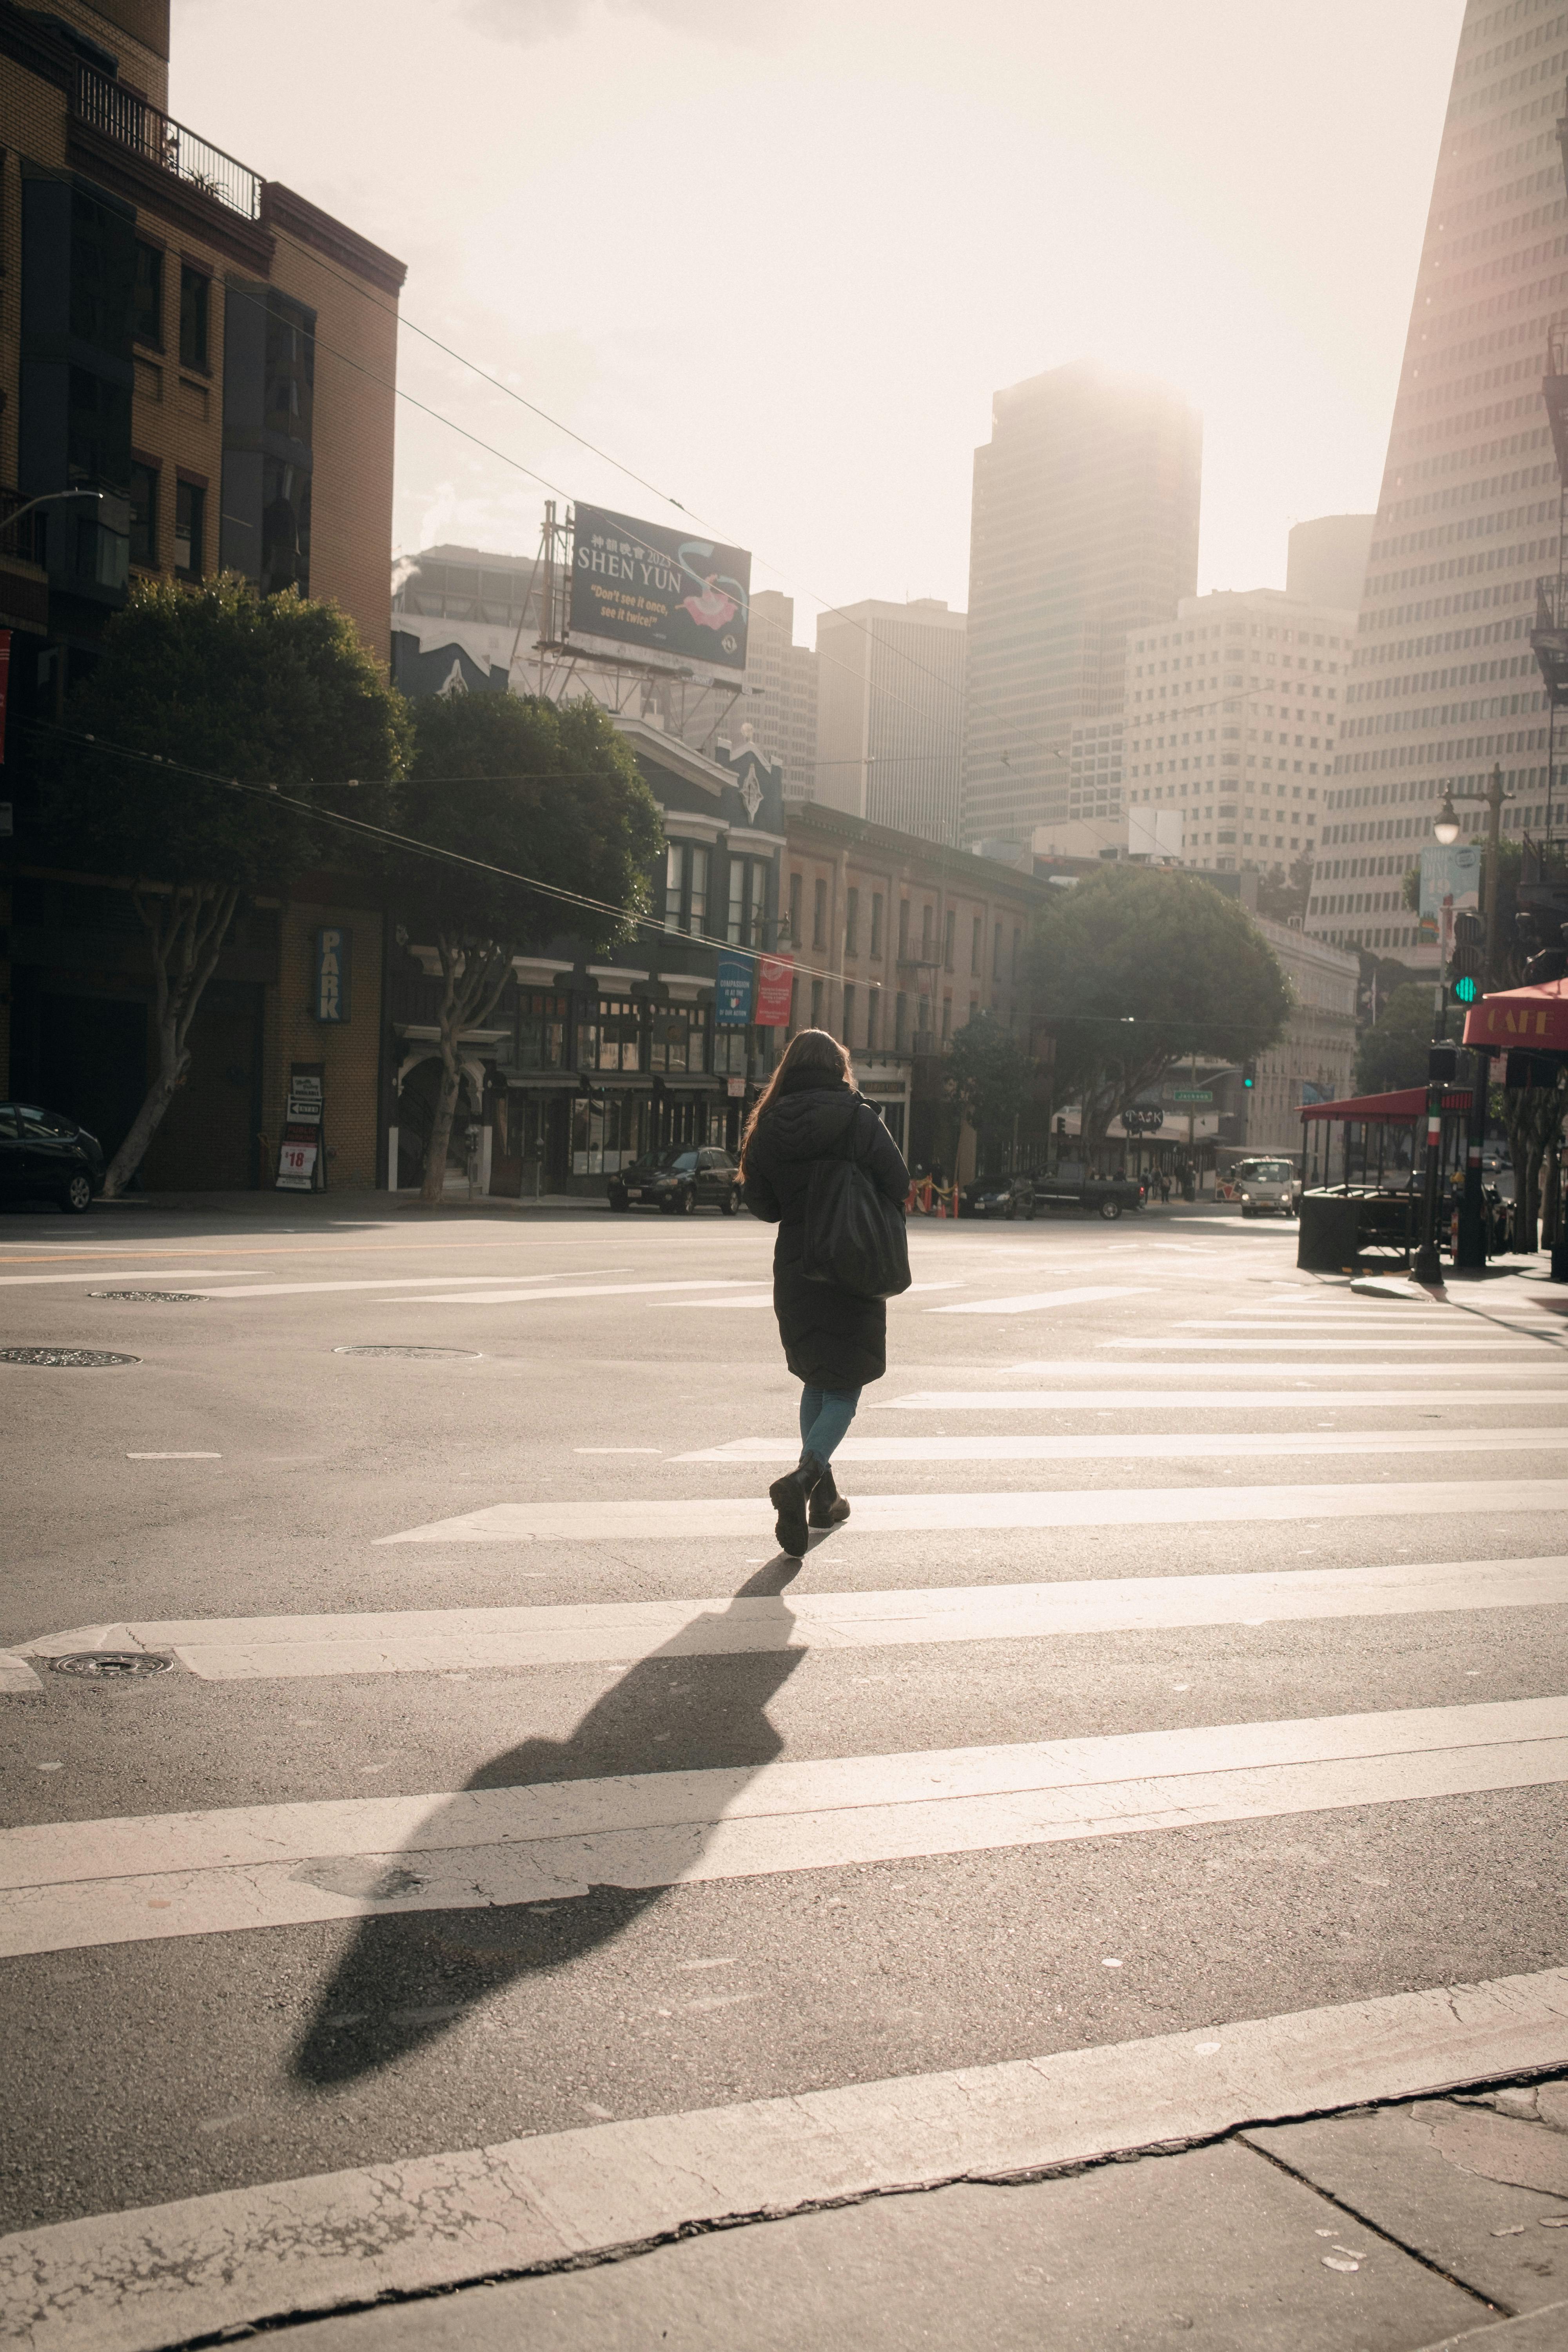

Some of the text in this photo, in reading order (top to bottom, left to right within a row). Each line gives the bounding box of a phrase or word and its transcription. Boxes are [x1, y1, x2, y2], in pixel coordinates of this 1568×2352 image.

[578, 547, 682, 593] SHEN YUN
[601, 606, 616, 618] see
[618, 608, 625, 620] it
[621, 594, 636, 606] see
[637, 596, 644, 608] it
[646, 601, 668, 616] once,
[320, 931, 340, 1018] PARK
[720, 980, 750, 988] COMPASSION
[1487, 1007, 1555, 1036] CAFE
[285, 1152, 304, 1167] $18
